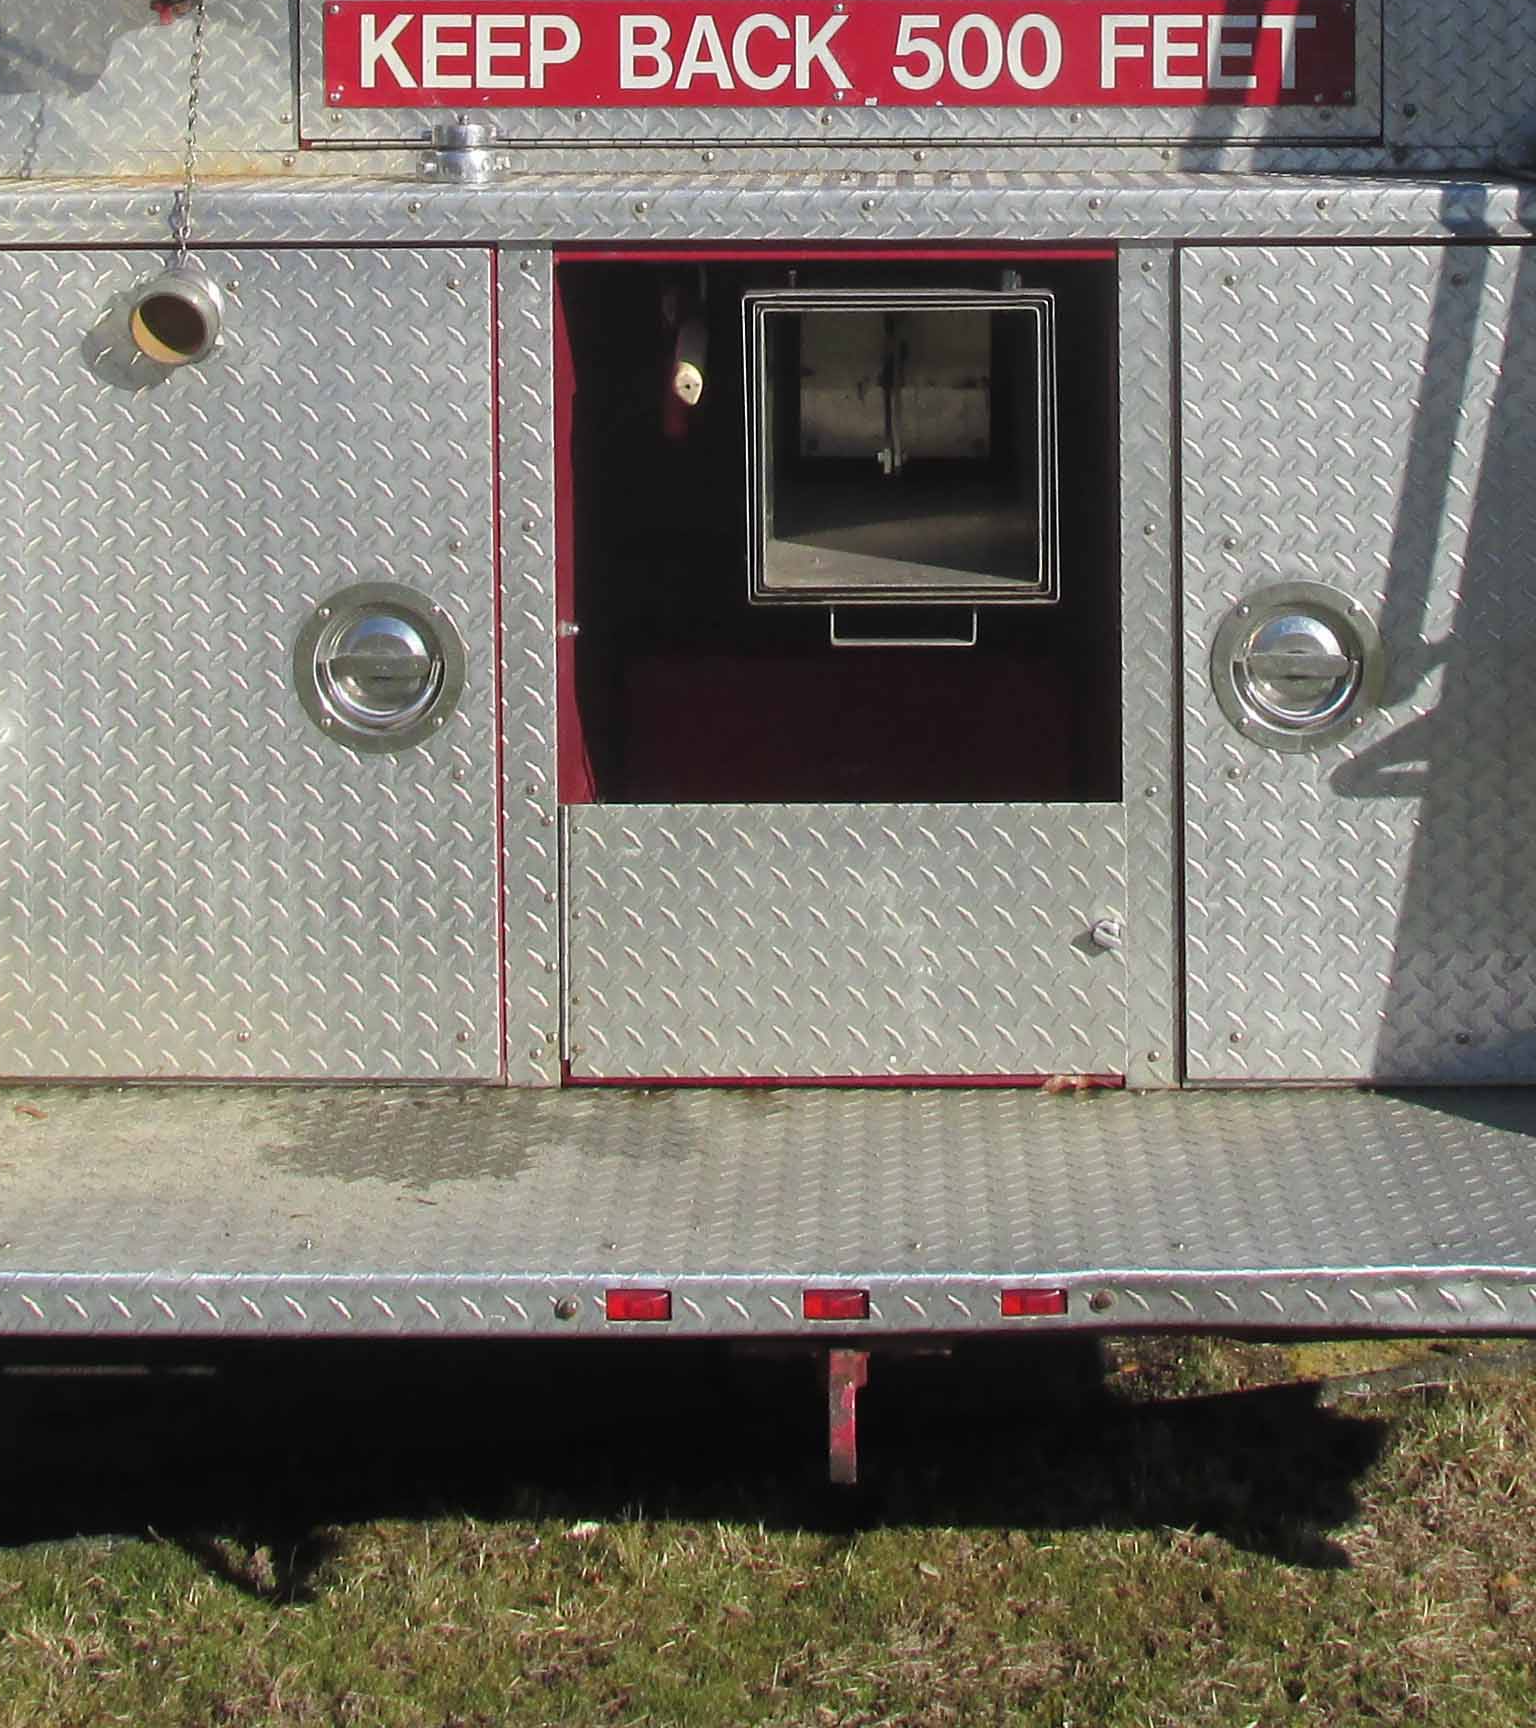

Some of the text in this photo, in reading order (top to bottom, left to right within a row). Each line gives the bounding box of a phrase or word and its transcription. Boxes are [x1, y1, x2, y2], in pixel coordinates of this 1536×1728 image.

[360, 13, 1317, 90] KEEP BACK 500 FEET
